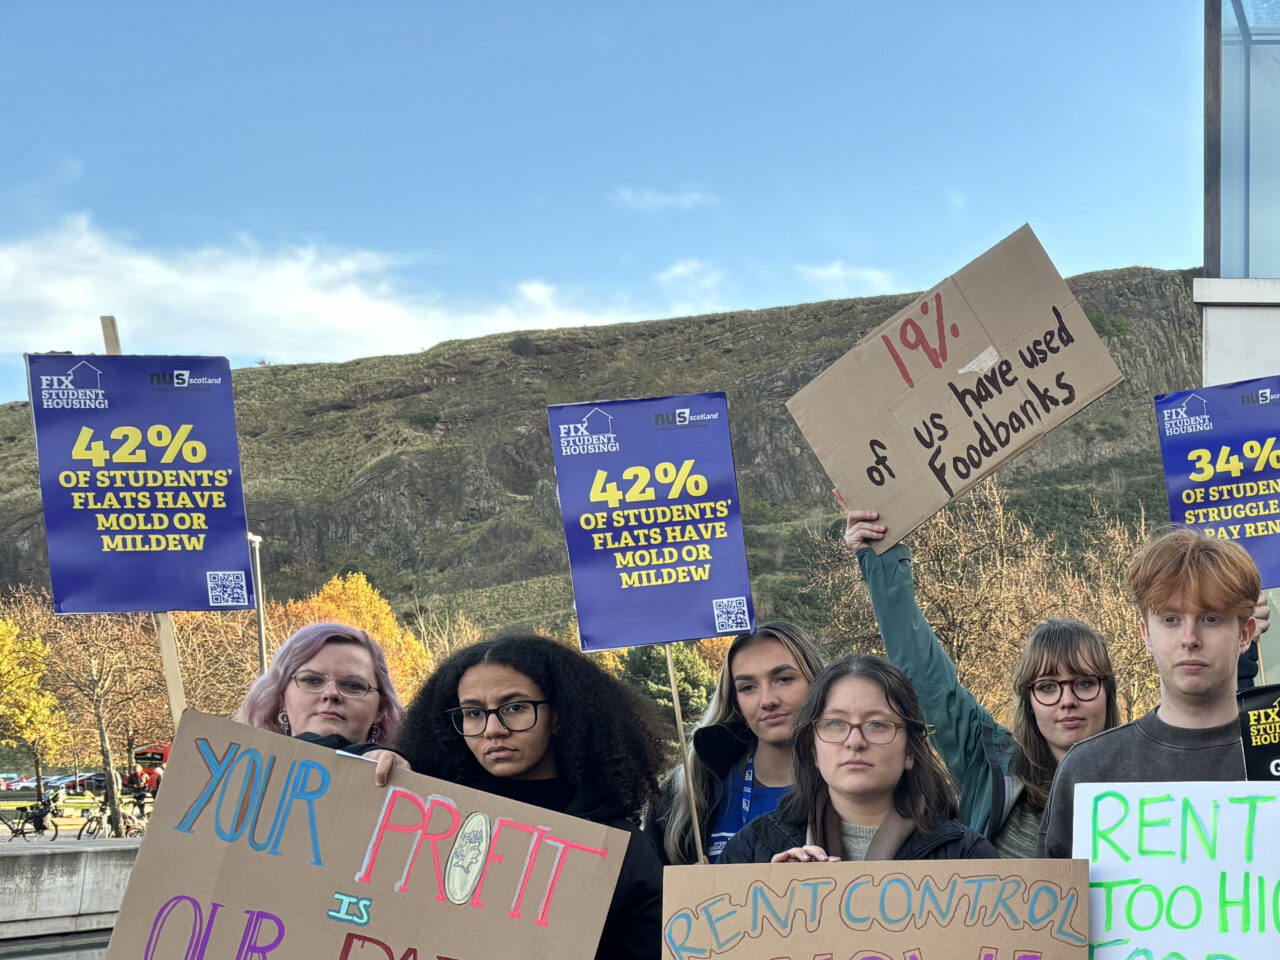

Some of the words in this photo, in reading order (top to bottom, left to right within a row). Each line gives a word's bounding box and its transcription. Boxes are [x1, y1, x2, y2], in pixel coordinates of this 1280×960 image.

[881, 292, 960, 388] 19%
[40, 376, 75, 389] FIX
[189, 376, 221, 384] scotland
[42, 390, 104, 400] STUDENT
[43, 400, 108, 408] HOUSING!
[866, 439, 896, 486] of
[914, 412, 948, 450] us
[947, 358, 1018, 418] have
[1018, 306, 1075, 369] used
[690, 412, 718, 422] scotland
[1162, 408, 1188, 420] FIX
[1164, 415, 1210, 429] STUDENT
[558, 424, 590, 436] FIX
[1166, 423, 1212, 436] HOUSING!
[72, 424, 206, 467] 42%
[560, 434, 616, 446] STUDENT
[562, 443, 620, 456] HOUSING!
[59, 471, 90, 487] OF
[96, 469, 232, 488] STUDENTS'
[590, 459, 708, 508] 42%
[72, 492, 151, 509] FLATS
[155, 492, 226, 508] HAVE
[1182, 488, 1204, 504] OF
[580, 513, 606, 530] OF
[612, 499, 732, 527] STUDENTS'
[1184, 500, 1280, 524] STRUGGLE
[96, 514, 168, 530] MOLD
[174, 513, 208, 530] OR
[101, 534, 206, 552] MILDEW
[592, 528, 662, 550] FLATS
[666, 522, 728, 542] HAVE
[614, 548, 678, 568] MOLD
[682, 544, 712, 562] OR
[620, 564, 710, 588] MILDEW
[173, 738, 330, 867] YOUR
[354, 785, 608, 927] PROFIT
[1092, 791, 1278, 864] RENT
[328, 891, 373, 926] IS
[839, 873, 1088, 946] CONTROL
[1089, 877, 1202, 932] TOO
